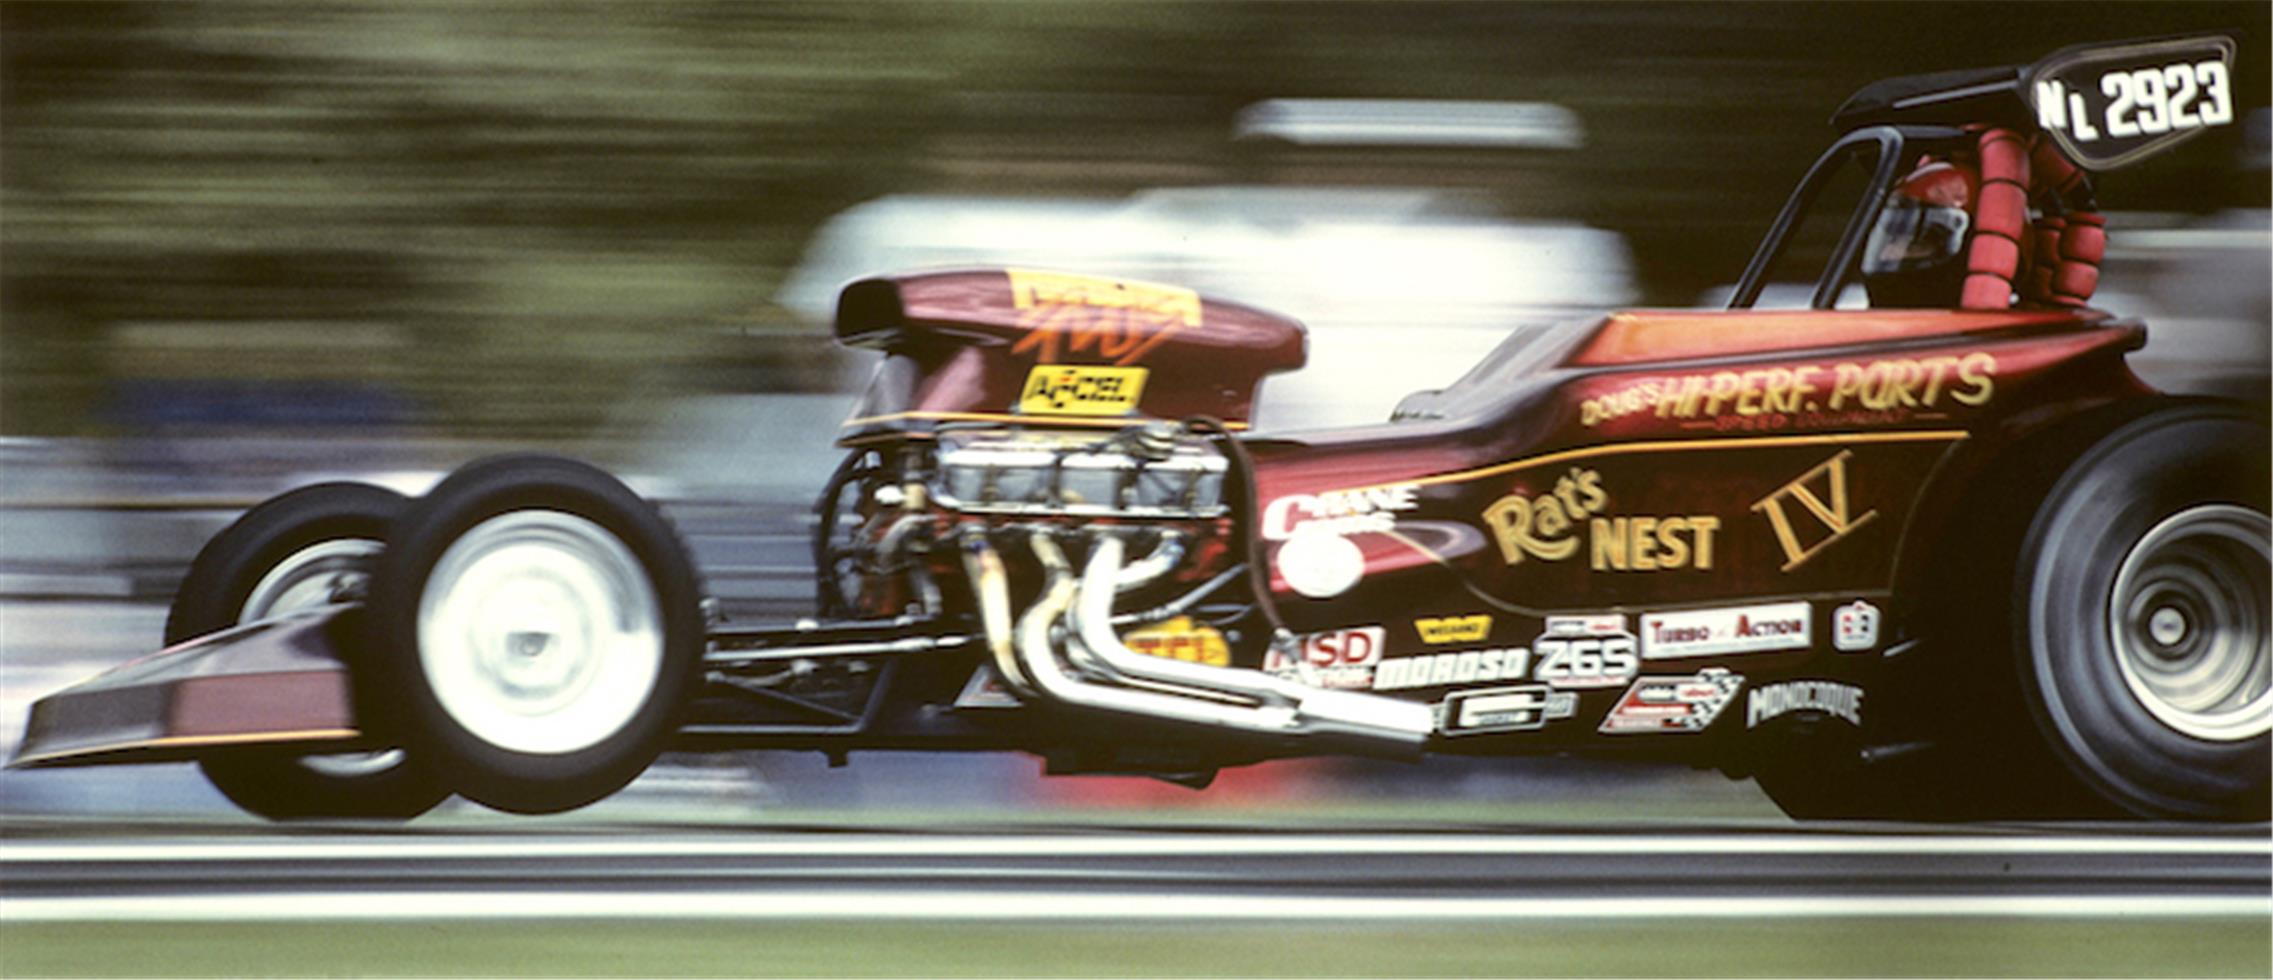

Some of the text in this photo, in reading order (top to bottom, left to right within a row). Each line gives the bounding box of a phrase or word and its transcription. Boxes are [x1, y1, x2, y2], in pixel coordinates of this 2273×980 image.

[2101, 60, 2233, 137] 2923
[1750, 448, 1878, 573] IV
[1590, 516, 1721, 572] NEST
[1373, 648, 1530, 690] MOROSO
